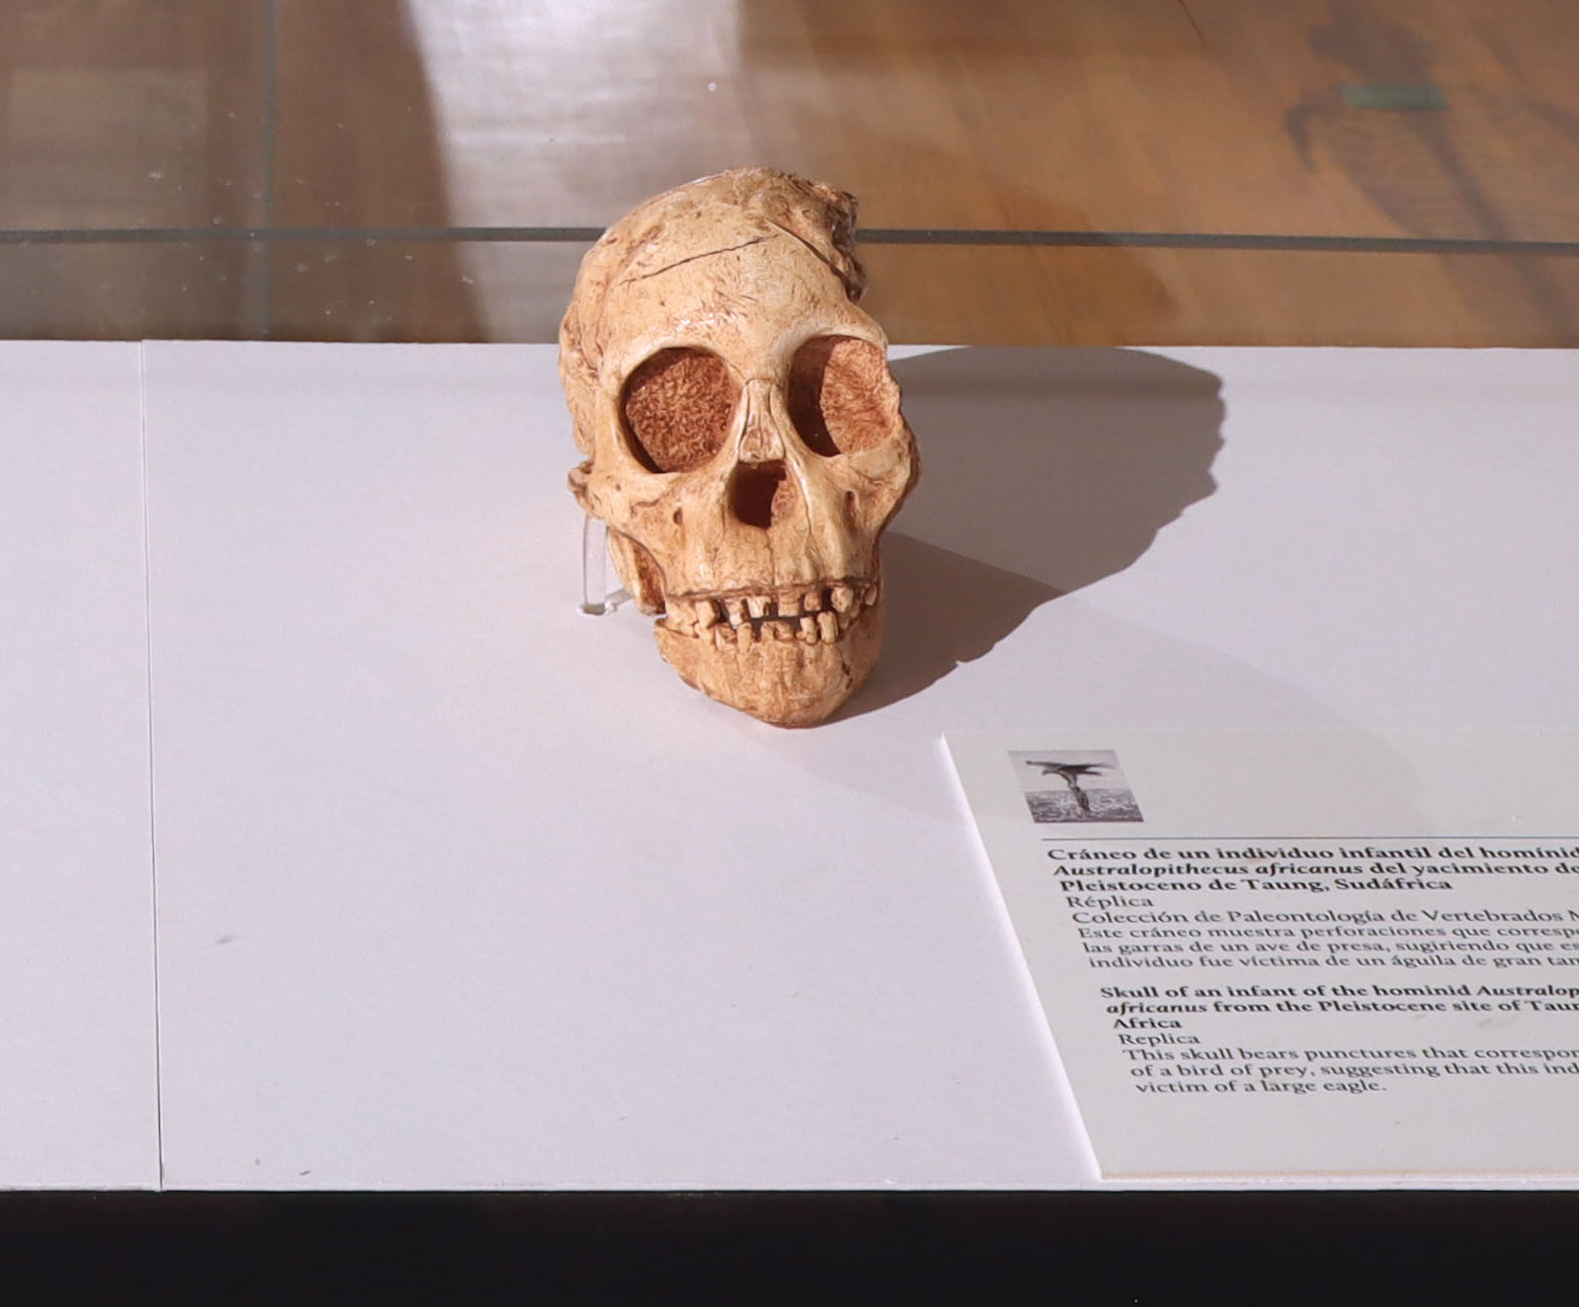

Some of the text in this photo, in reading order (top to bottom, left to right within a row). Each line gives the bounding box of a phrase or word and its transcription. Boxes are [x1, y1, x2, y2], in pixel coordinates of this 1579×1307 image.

[1047, 848, 1136, 860] Cráneo
[1143, 848, 1170, 860] de
[1177, 851, 1210, 859] un
[1216, 847, 1333, 859] individuo
[1339, 847, 1431, 859] infantil
[1437, 847, 1474, 859] del
[1055, 863, 1248, 878] Australopithecus
[1255, 863, 1362, 875] africanus
[1369, 862, 1406, 874] del
[1412, 862, 1548, 877] yacimiento
[1060, 878, 1451, 893] Pleistoceno de Taung, Sudáfrica
[1066, 895, 1153, 910] Réplica
[1072, 911, 1188, 923] Colección
[1193, 911, 1220, 923] de
[1227, 911, 1384, 925] Paleontología
[1390, 910, 1416, 922] de
[1422, 910, 1563, 922] Vertebrados
[1100, 986, 1158, 998] Skull
[1164, 986, 1187, 998] of
[1194, 989, 1222, 998] an
[1227, 985, 1296, 997] infant
[1302, 985, 1325, 997] of
[1331, 985, 1367, 997] the
[1372, 985, 1471, 997] hominid
[1106, 1001, 1207, 1013] africanus
[1213, 1000, 1270, 1012] from
[1275, 1000, 1311, 1012] the
[1318, 1000, 1445, 1012] Pleistocene
[1452, 1000, 1490, 1012] site
[1497, 999, 1520, 1011] of
[1113, 1016, 1181, 1028] Africa
[1118, 1032, 1200, 1047] Replica
[1135, 1080, 1387, 1094] victim of a large eagle.
